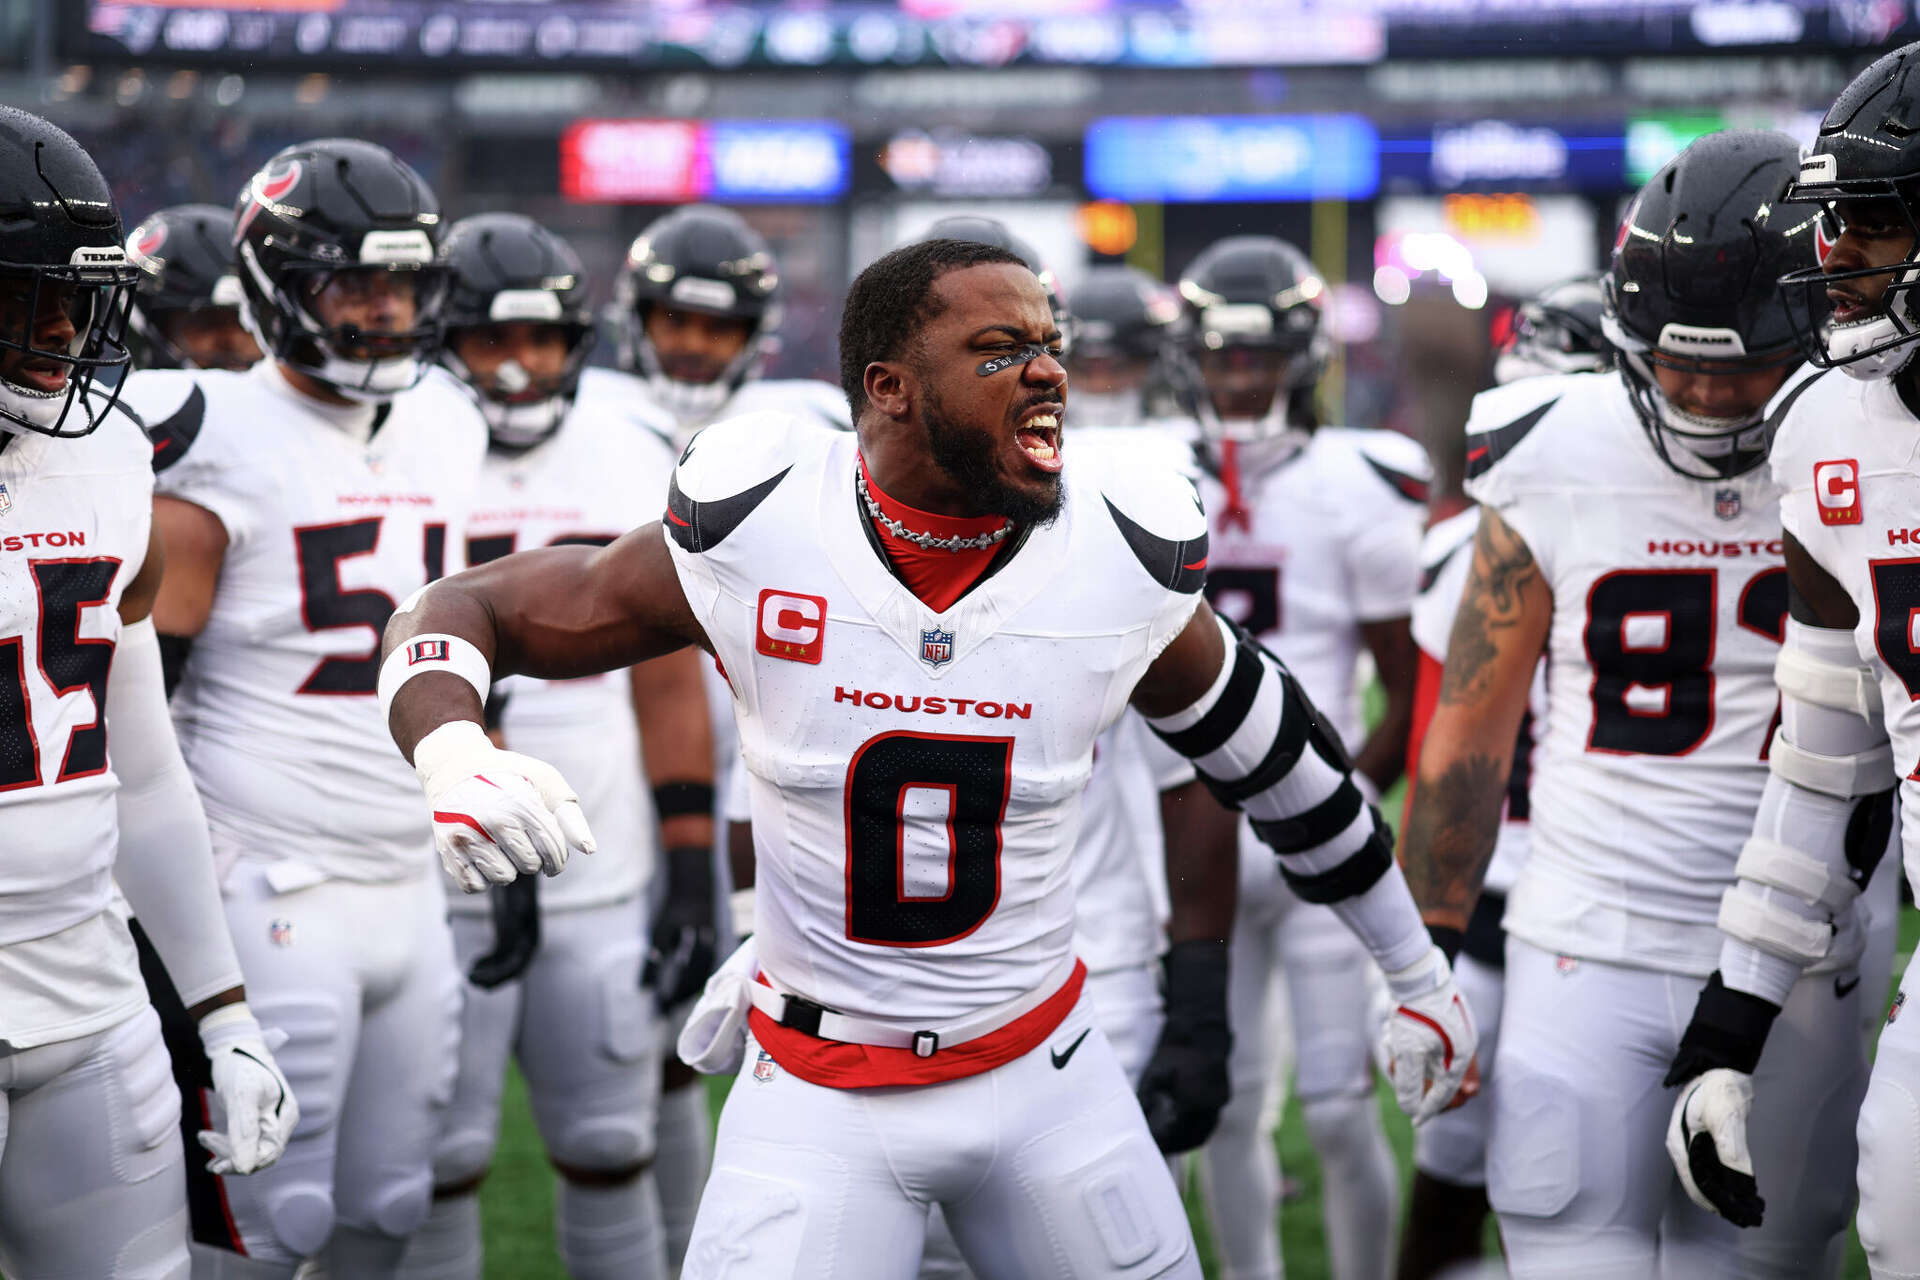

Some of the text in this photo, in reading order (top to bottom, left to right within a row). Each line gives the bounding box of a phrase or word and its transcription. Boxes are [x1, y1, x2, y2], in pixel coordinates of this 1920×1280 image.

[83, 253, 125, 262] TEXANS
[1817, 464, 1856, 508] C
[0, 531, 86, 552] STON
[1648, 540, 1783, 557] HOUSTO
[761, 594, 820, 645] C
[924, 643, 950, 662] NFL
[0, 556, 123, 793] 5
[834, 686, 1032, 719] HOUSTON
[844, 729, 1016, 948] 0
